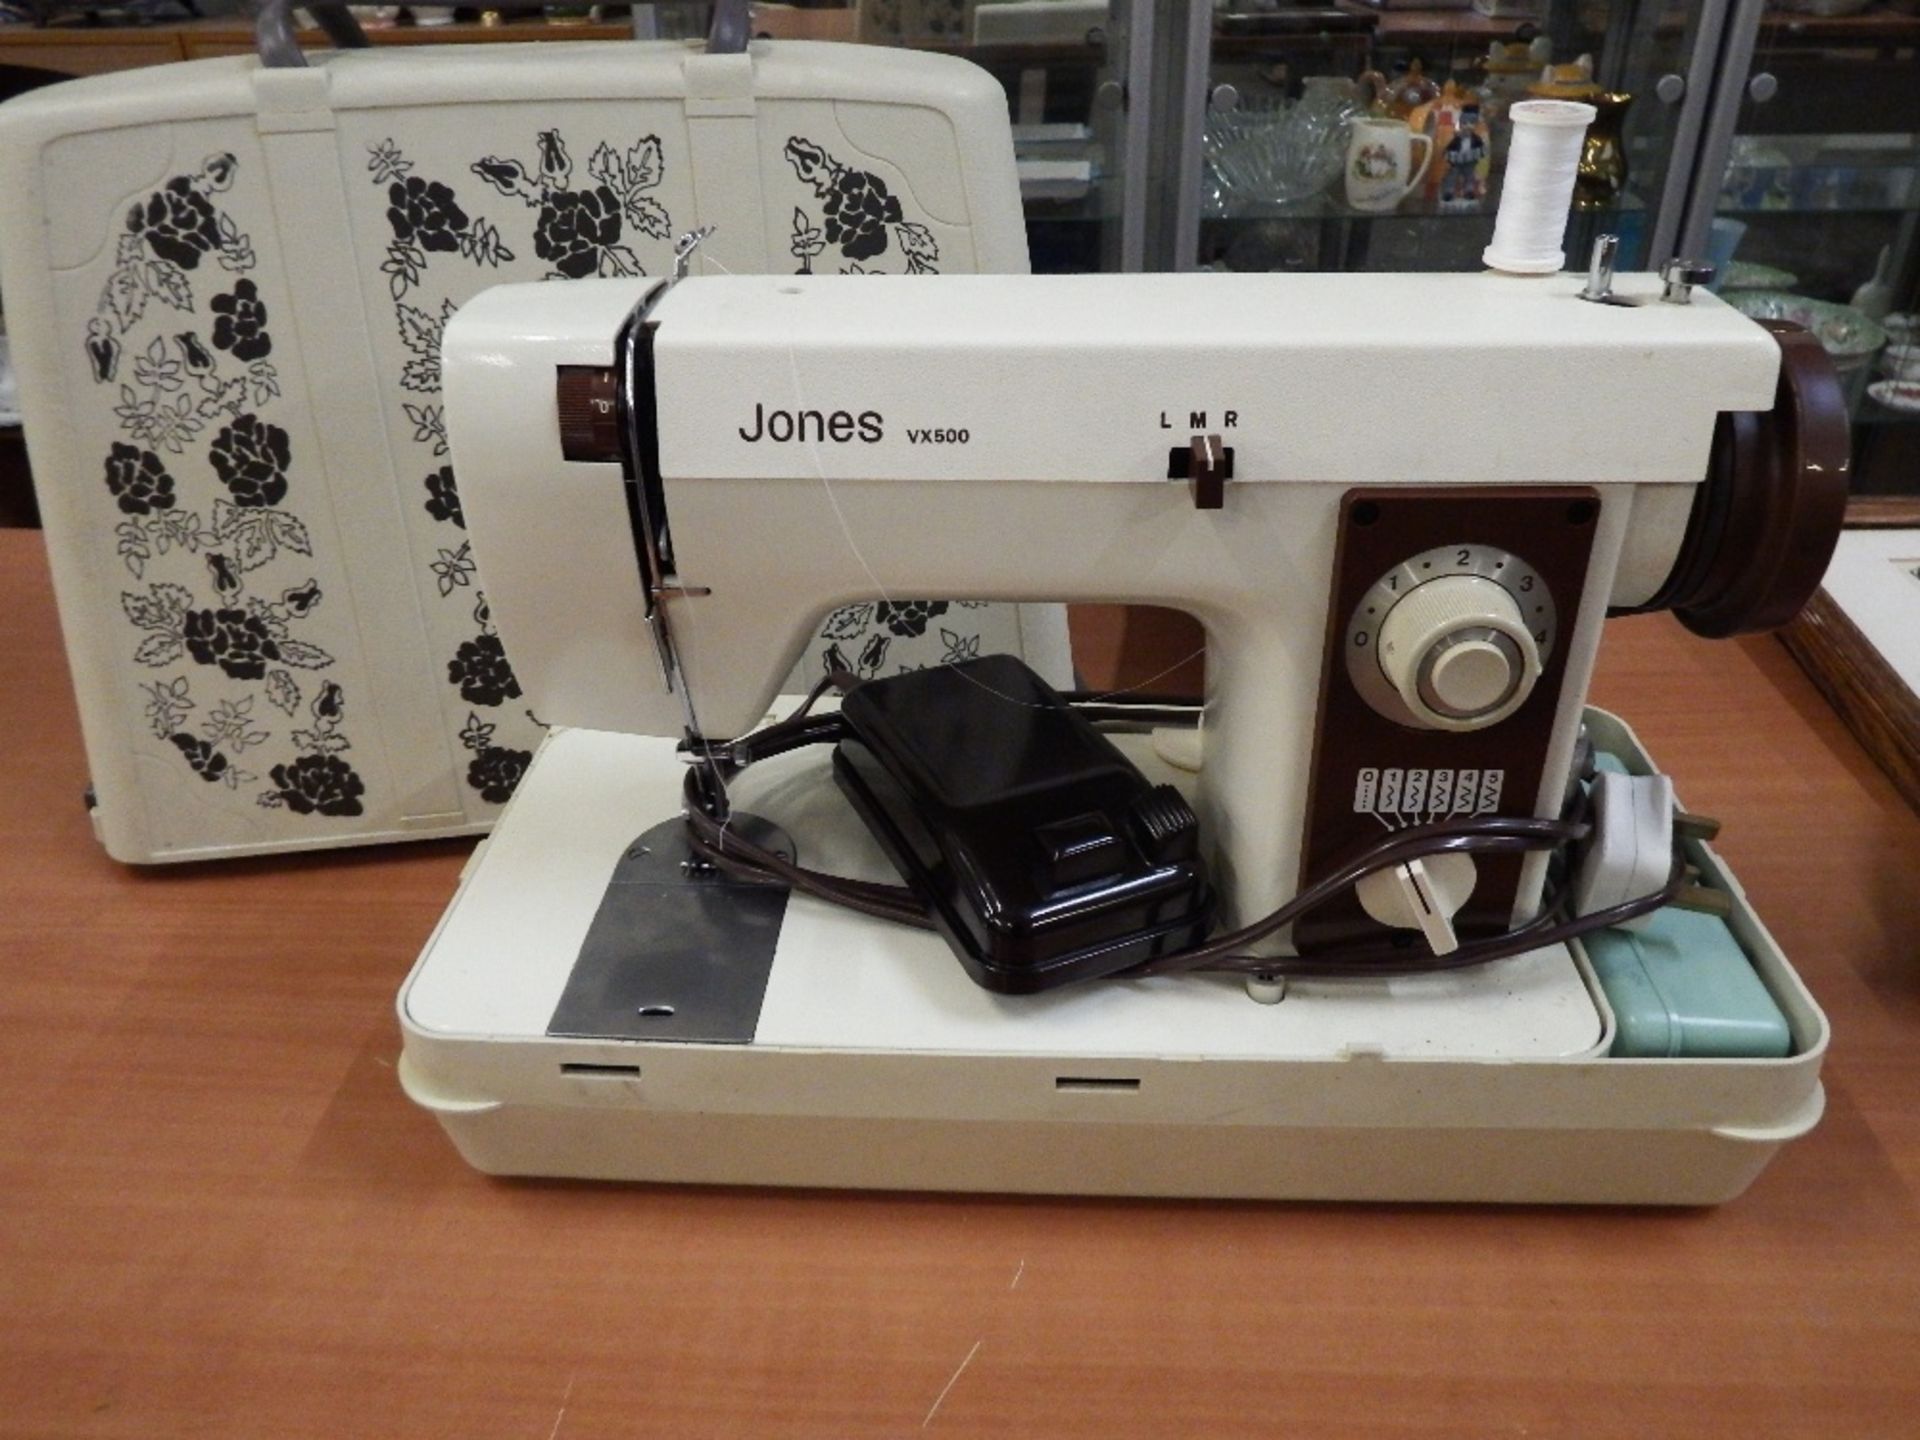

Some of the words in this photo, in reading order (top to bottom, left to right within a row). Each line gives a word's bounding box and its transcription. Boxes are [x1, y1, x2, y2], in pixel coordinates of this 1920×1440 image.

[739, 403, 883, 443] Jones
[906, 429, 970, 444] VX500
[1160, 411, 1172, 429] L
[1189, 411, 1207, 429] M
[1224, 410, 1239, 428] R
[1354, 631, 1369, 648] 0
[1389, 575, 1398, 591] 1
[1456, 549, 1471, 566] 2
[1519, 575, 1534, 593] 3
[1363, 771, 1374, 783] 0
[1390, 771, 1398, 782] 1
[1413, 771, 1424, 783] 2
[1439, 771, 1450, 783] 3
[1464, 771, 1474, 783] 4
[1489, 771, 1500, 784] 5
